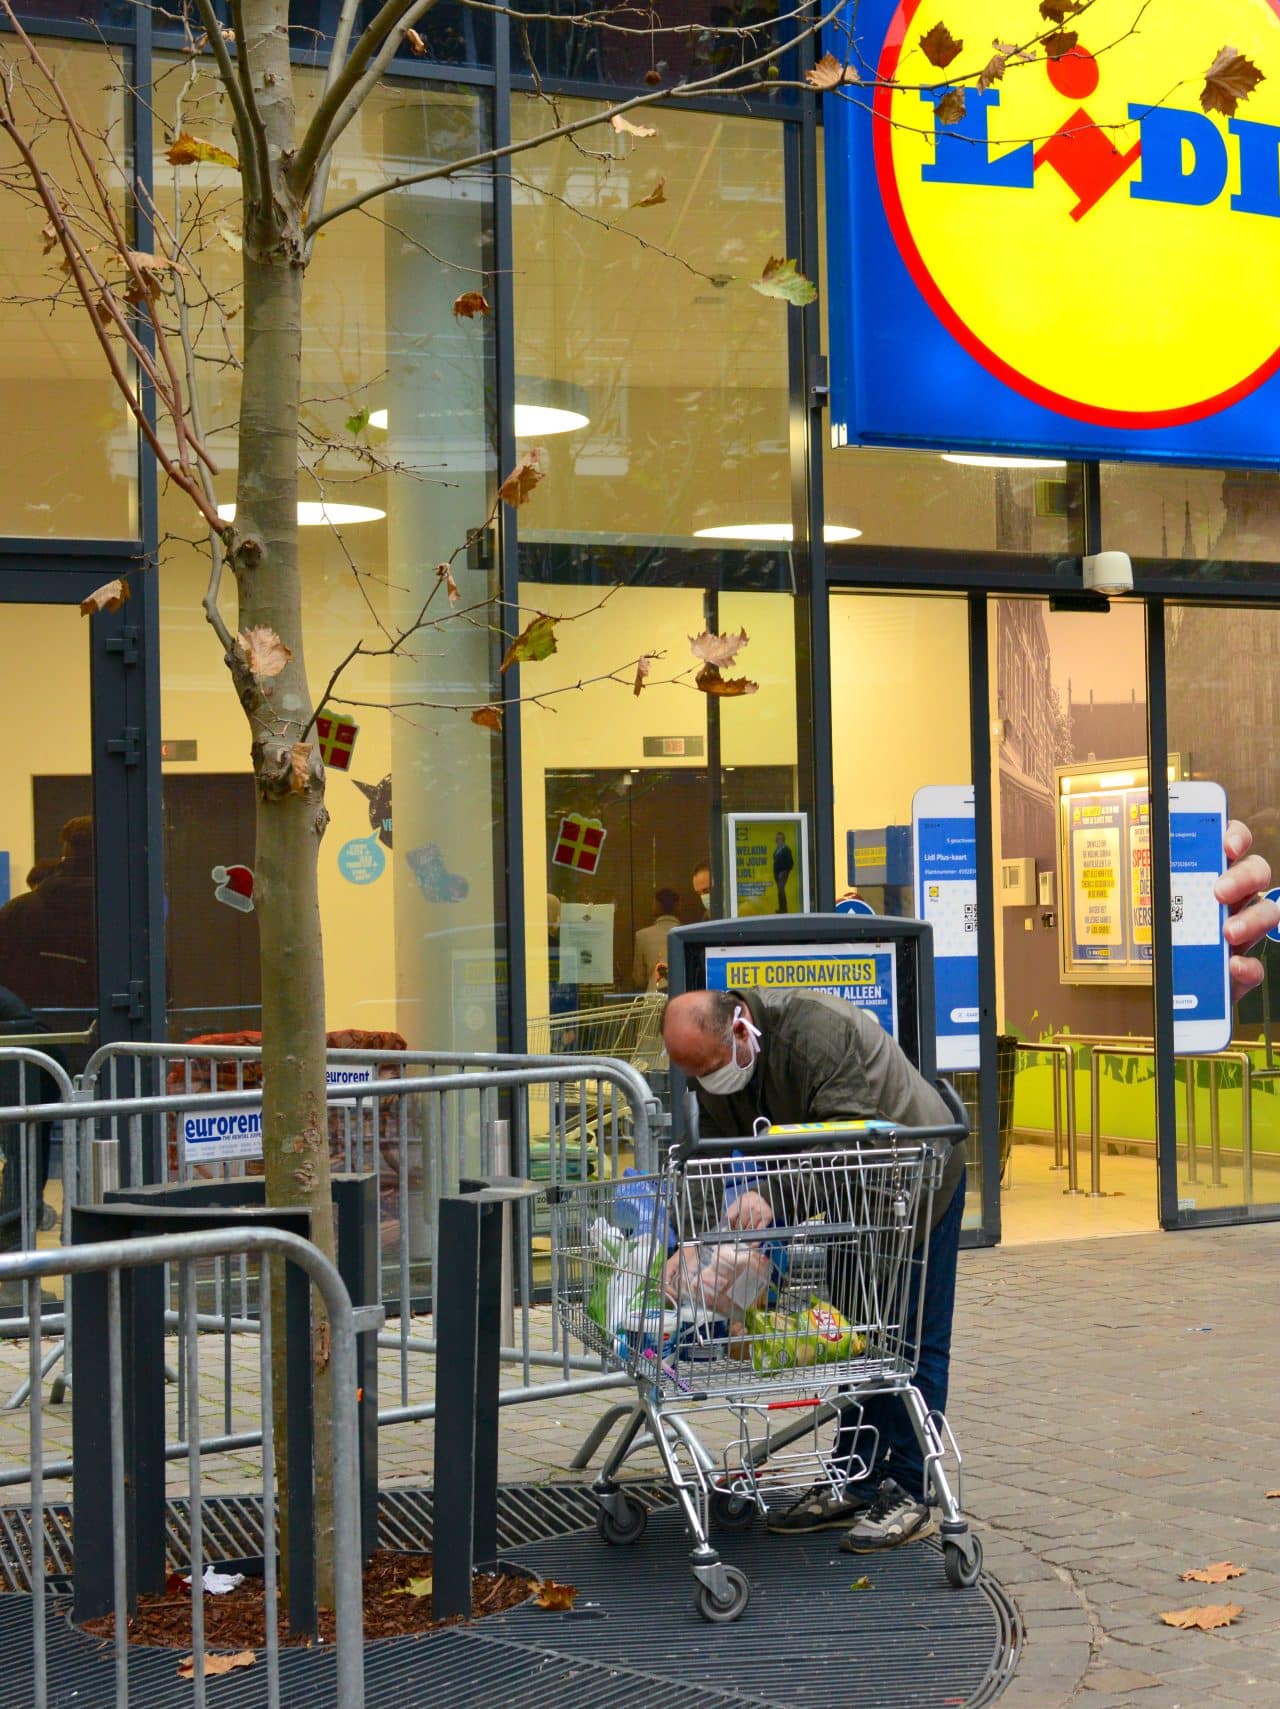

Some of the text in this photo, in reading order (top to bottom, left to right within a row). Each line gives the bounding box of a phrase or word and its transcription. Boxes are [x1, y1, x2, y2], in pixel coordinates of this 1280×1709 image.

[731, 963, 872, 985] HET CORONAVIRUS
[843, 985, 882, 1000] ALLEEN
[325, 1070, 370, 1084] eurorent
